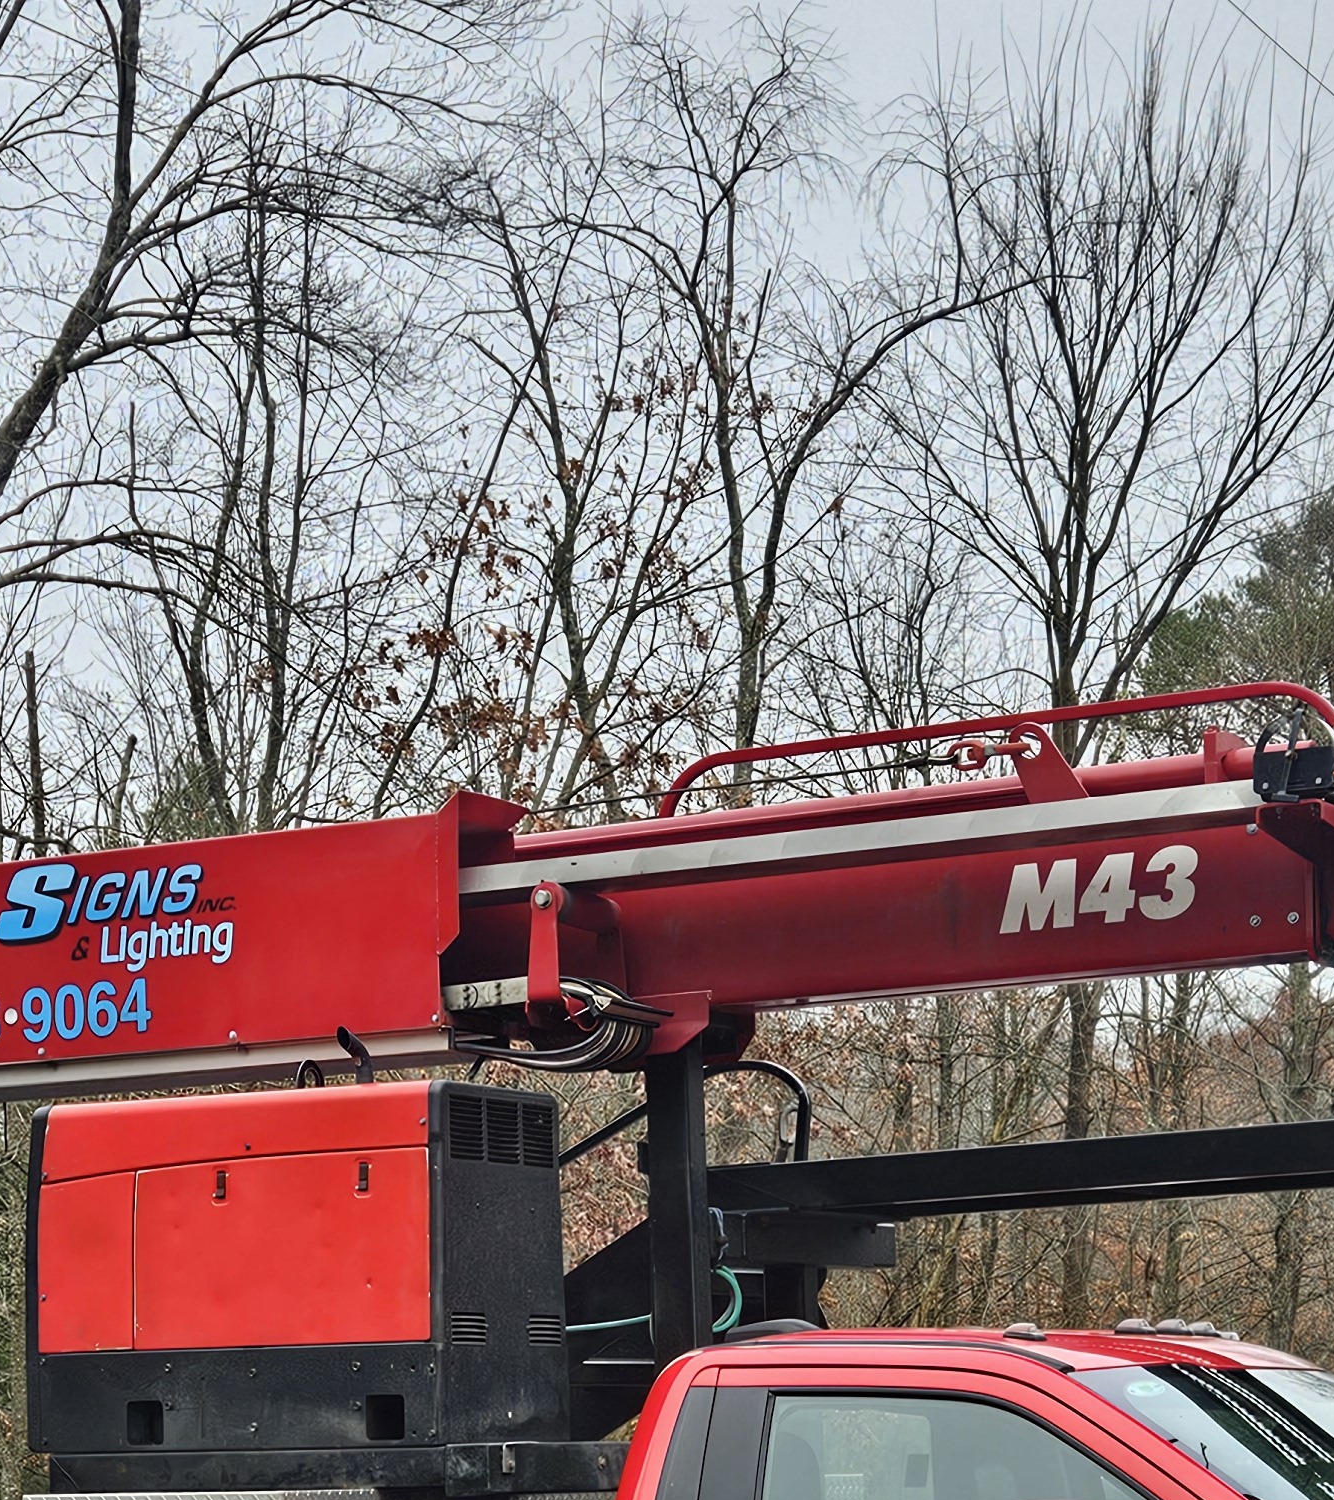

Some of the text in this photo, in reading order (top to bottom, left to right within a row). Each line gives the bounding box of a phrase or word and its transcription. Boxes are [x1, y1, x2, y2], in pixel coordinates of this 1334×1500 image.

[999, 844, 1199, 934] M43
[71, 916, 235, 972] & Lighting
